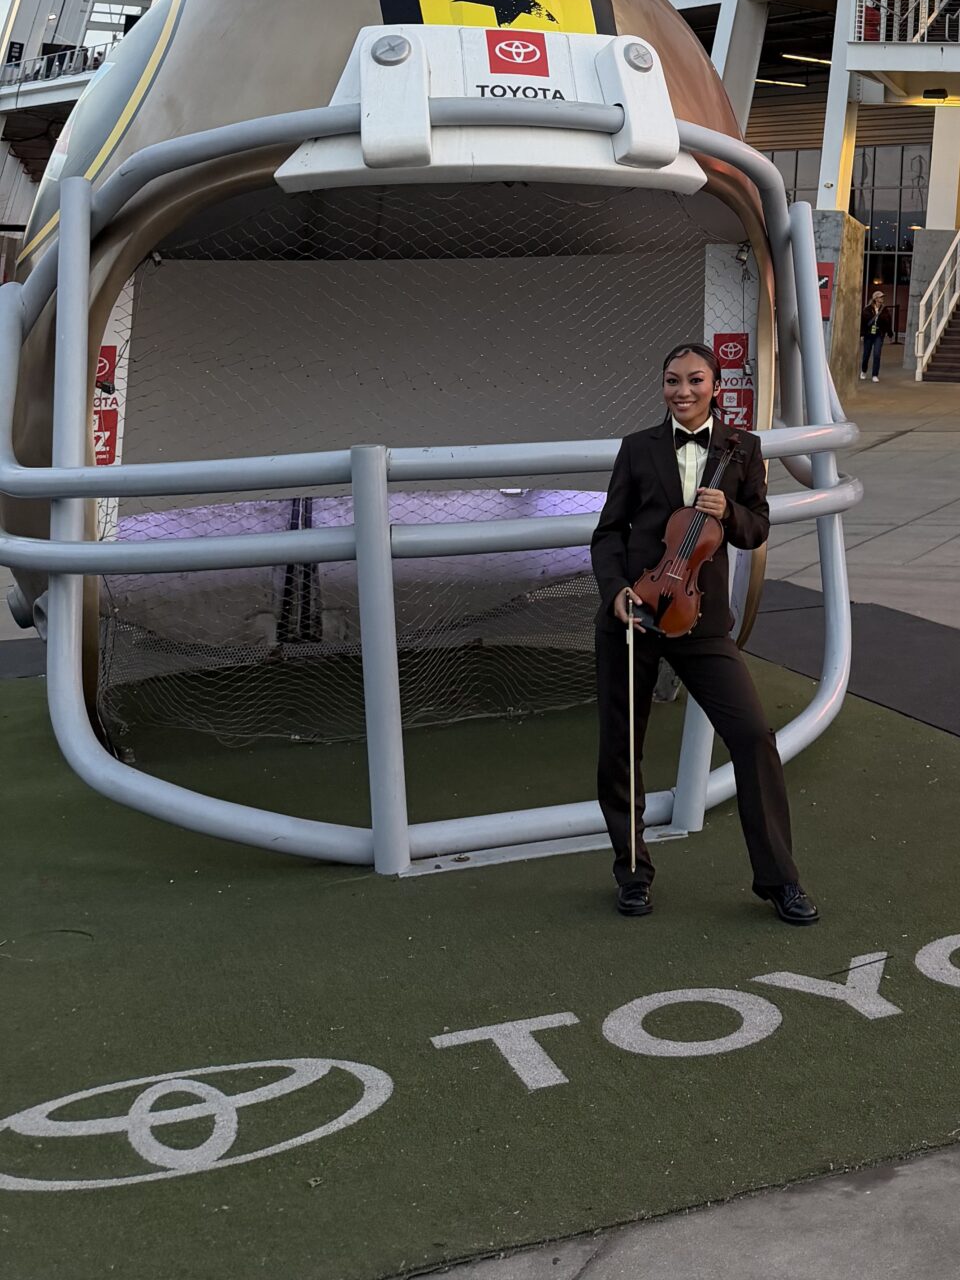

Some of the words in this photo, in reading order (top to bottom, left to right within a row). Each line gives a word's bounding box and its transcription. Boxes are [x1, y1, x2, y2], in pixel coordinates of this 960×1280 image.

[475, 84, 566, 101] TOYOTA
[721, 377, 753, 387] YOTA
[94, 397, 119, 408] OTA
